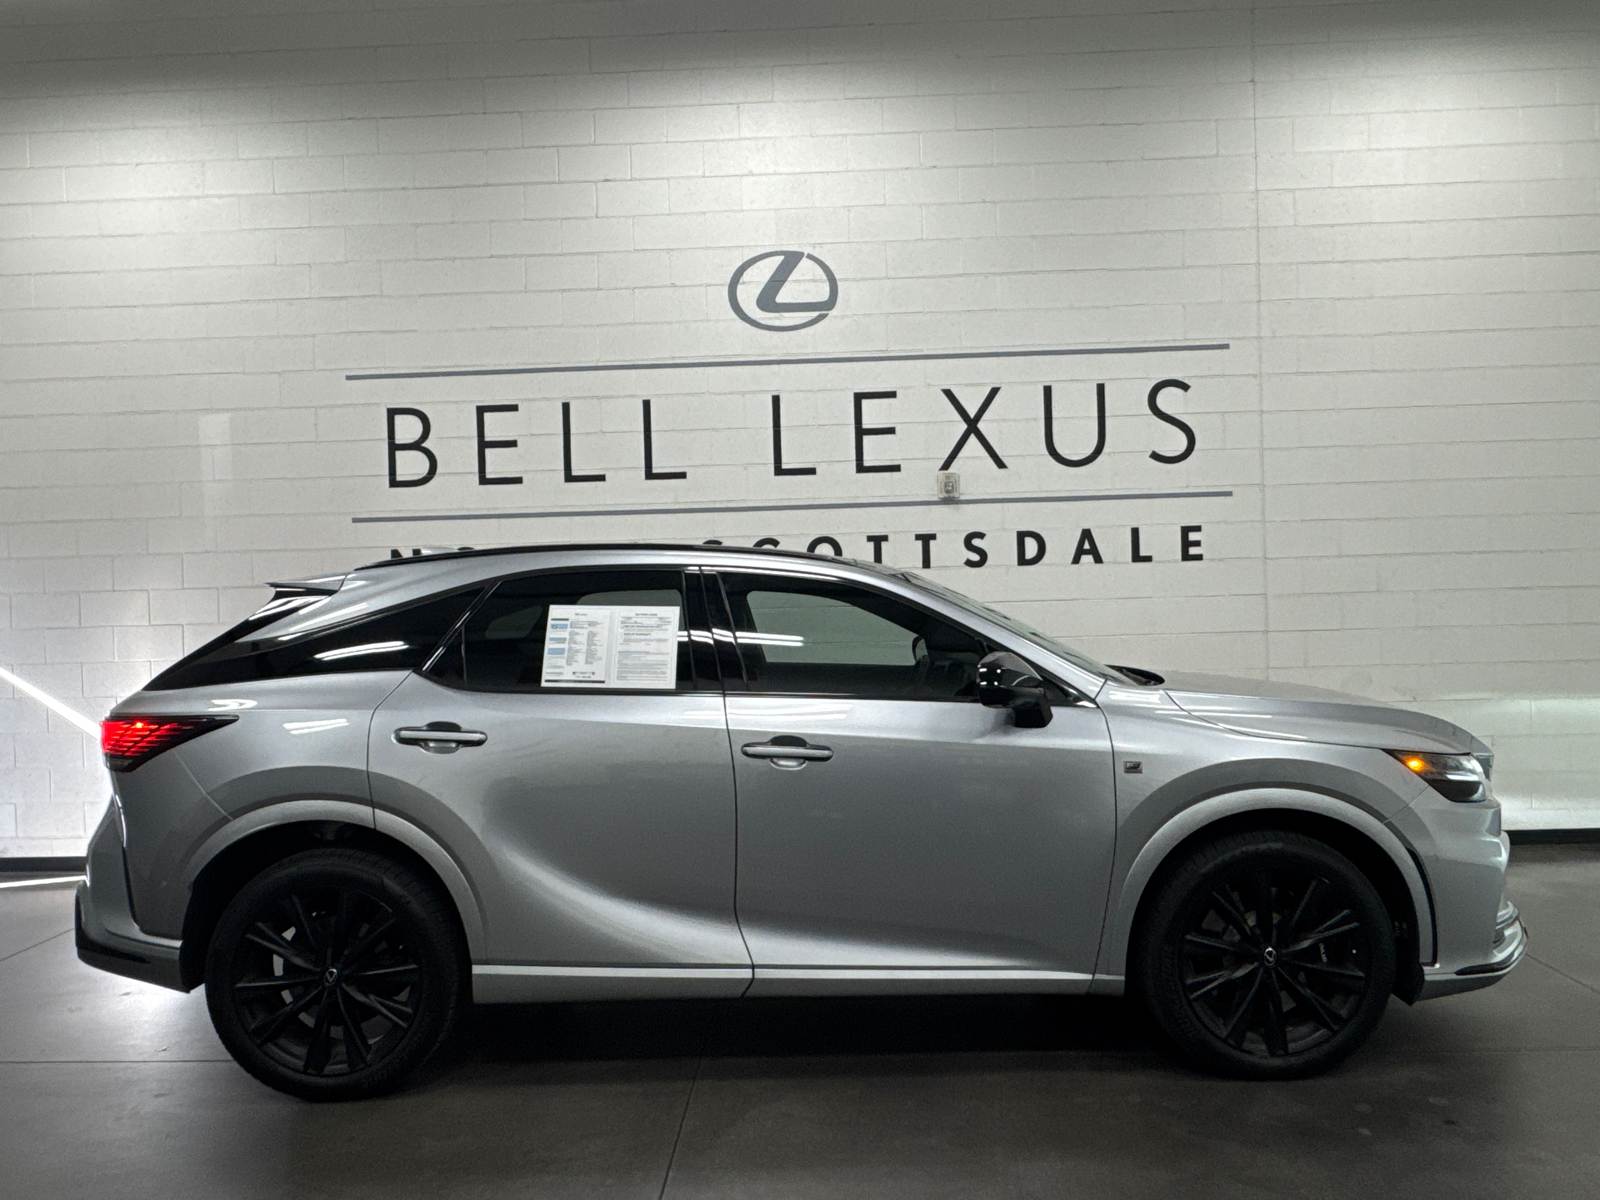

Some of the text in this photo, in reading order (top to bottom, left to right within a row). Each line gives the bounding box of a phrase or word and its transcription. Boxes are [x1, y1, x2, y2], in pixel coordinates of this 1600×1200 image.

[386, 378, 1196, 488] BELL LEXUS
[702, 525, 1203, 569] OTTSDALE
